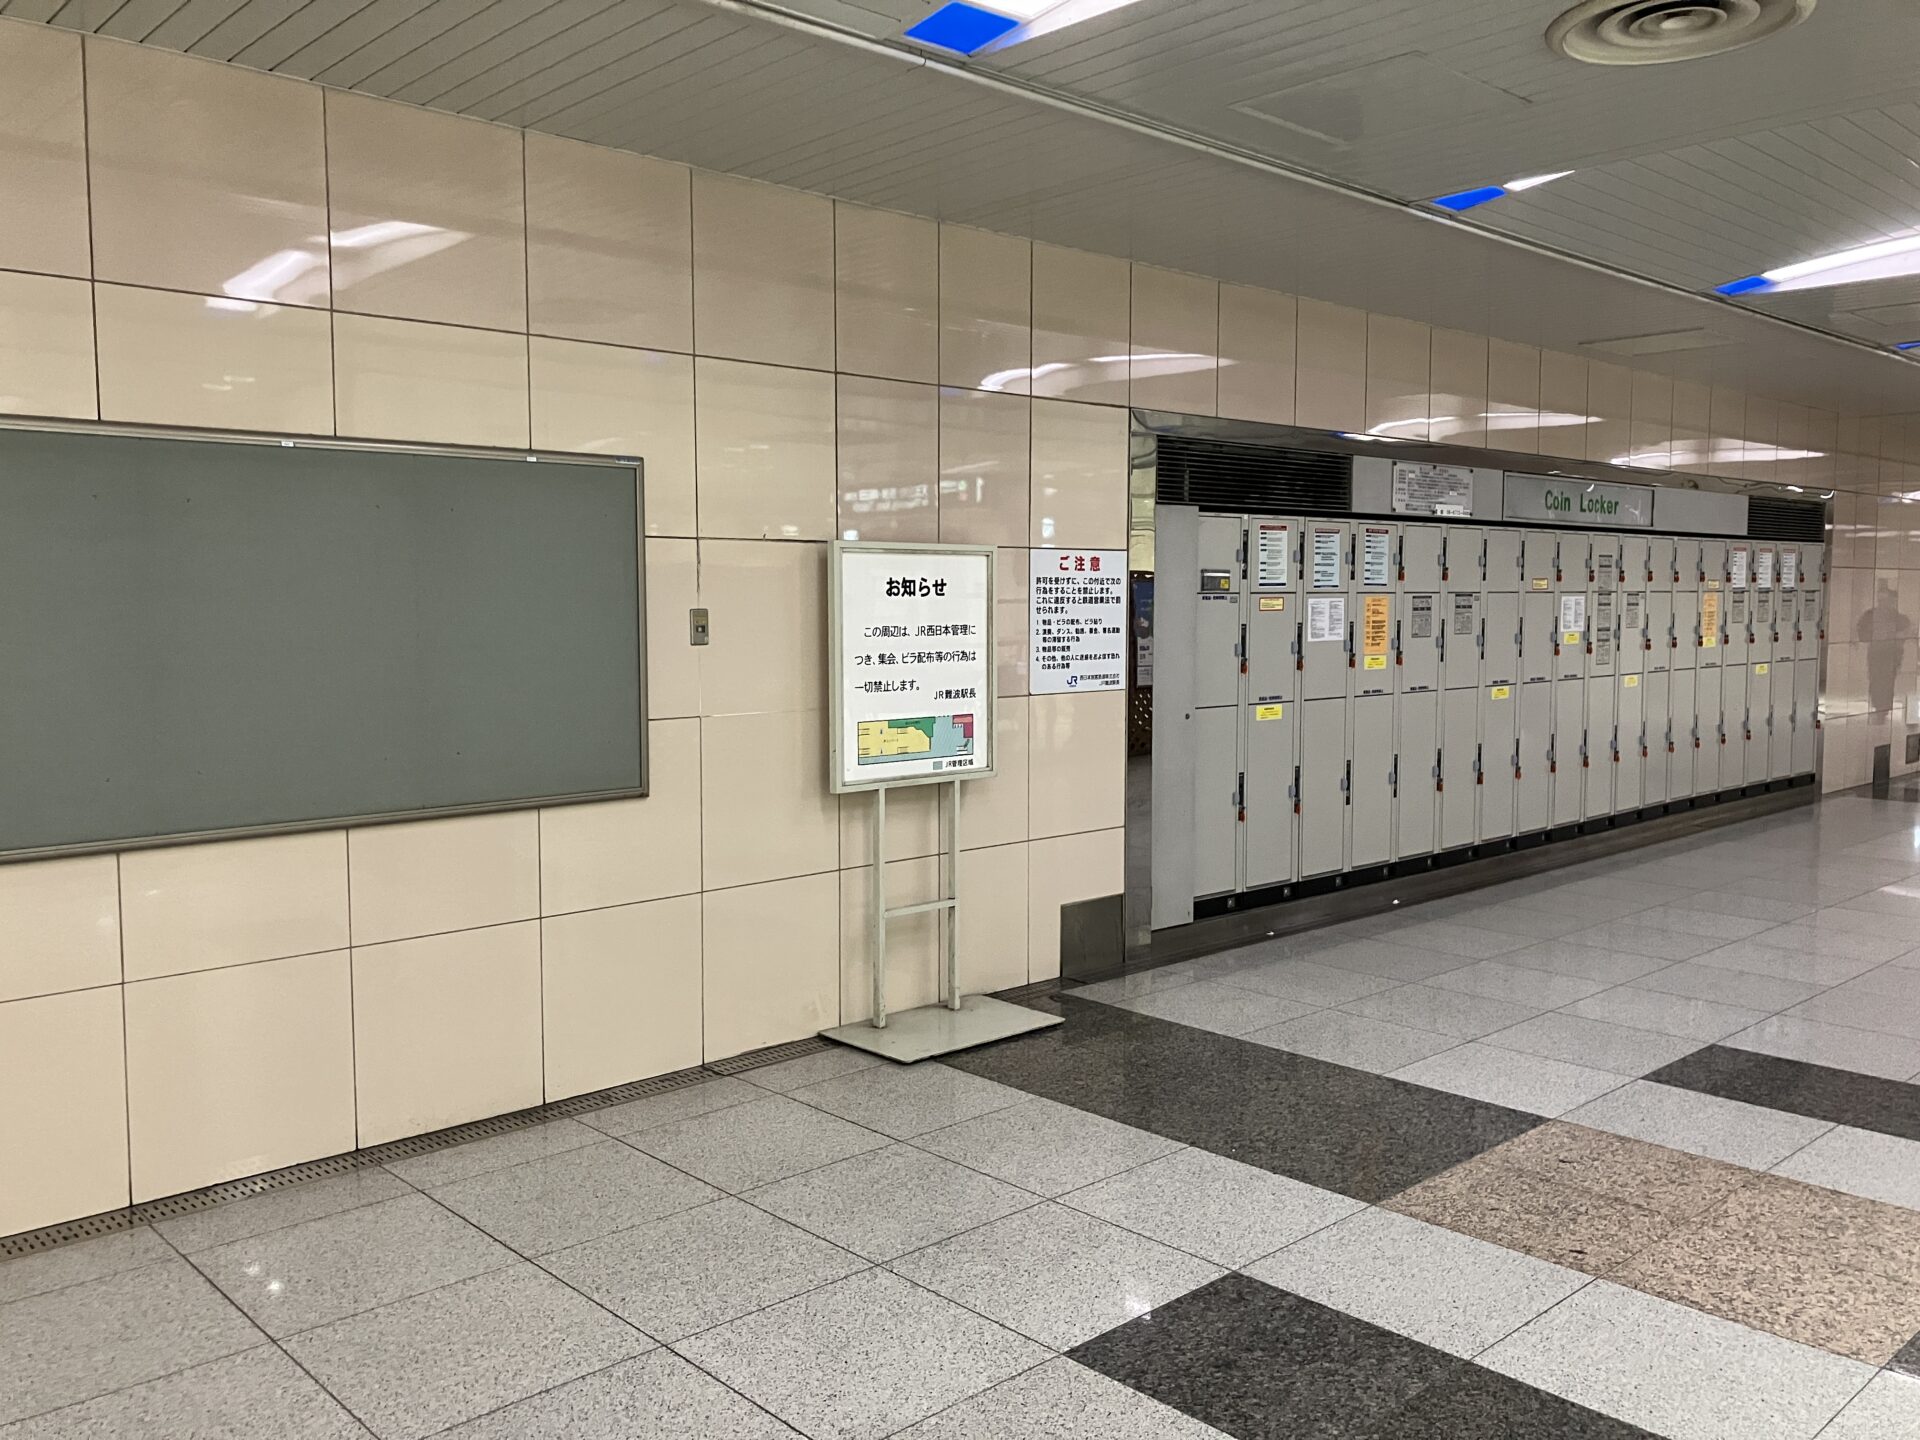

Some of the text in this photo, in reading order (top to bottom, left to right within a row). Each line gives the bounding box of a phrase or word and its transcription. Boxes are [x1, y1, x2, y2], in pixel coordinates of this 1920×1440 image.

[1545, 489, 1619, 515] Coin Locker
[1059, 556, 1101, 572] ご注意
[886, 577, 947, 597] お知らせ
[1036, 586, 1113, 595] 行為をすることを禁止します。
[1036, 606, 1068, 614] せられます。
[864, 624, 976, 638] この周辺は、JR西日本管理に
[854, 651, 976, 666] つき、集会、ビラ配布等の行為は
[854, 680, 920, 694] 一切禁止します。
[1067, 675, 1078, 685] JR
[934, 688, 977, 700] JR難波駅長
